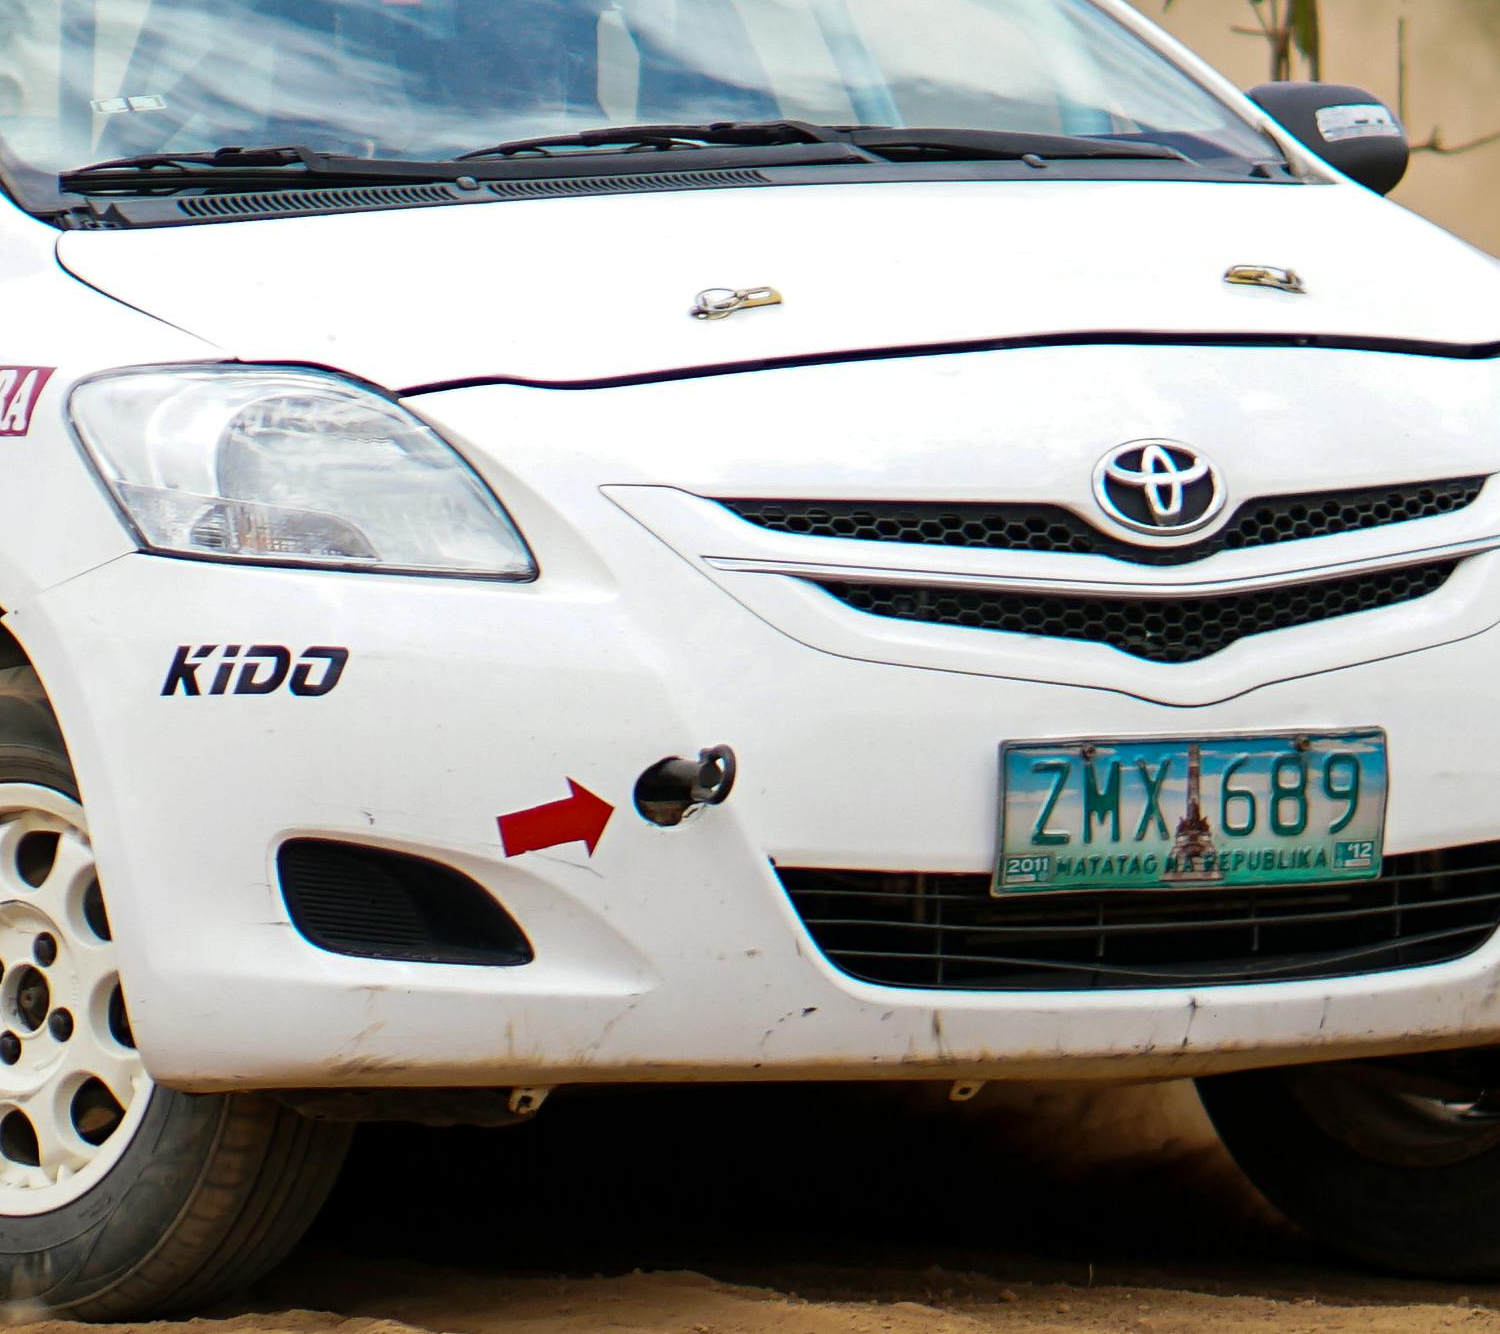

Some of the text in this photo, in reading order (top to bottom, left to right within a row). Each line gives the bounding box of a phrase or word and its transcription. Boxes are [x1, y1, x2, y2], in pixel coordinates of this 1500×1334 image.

[1030, 756, 1171, 845] ZMX
[1220, 751, 1361, 838] 689
[1008, 857, 1049, 874] 2011
[1054, 853, 1158, 877] MATATAG
[1202, 848, 1327, 875] REPUBLIKA
